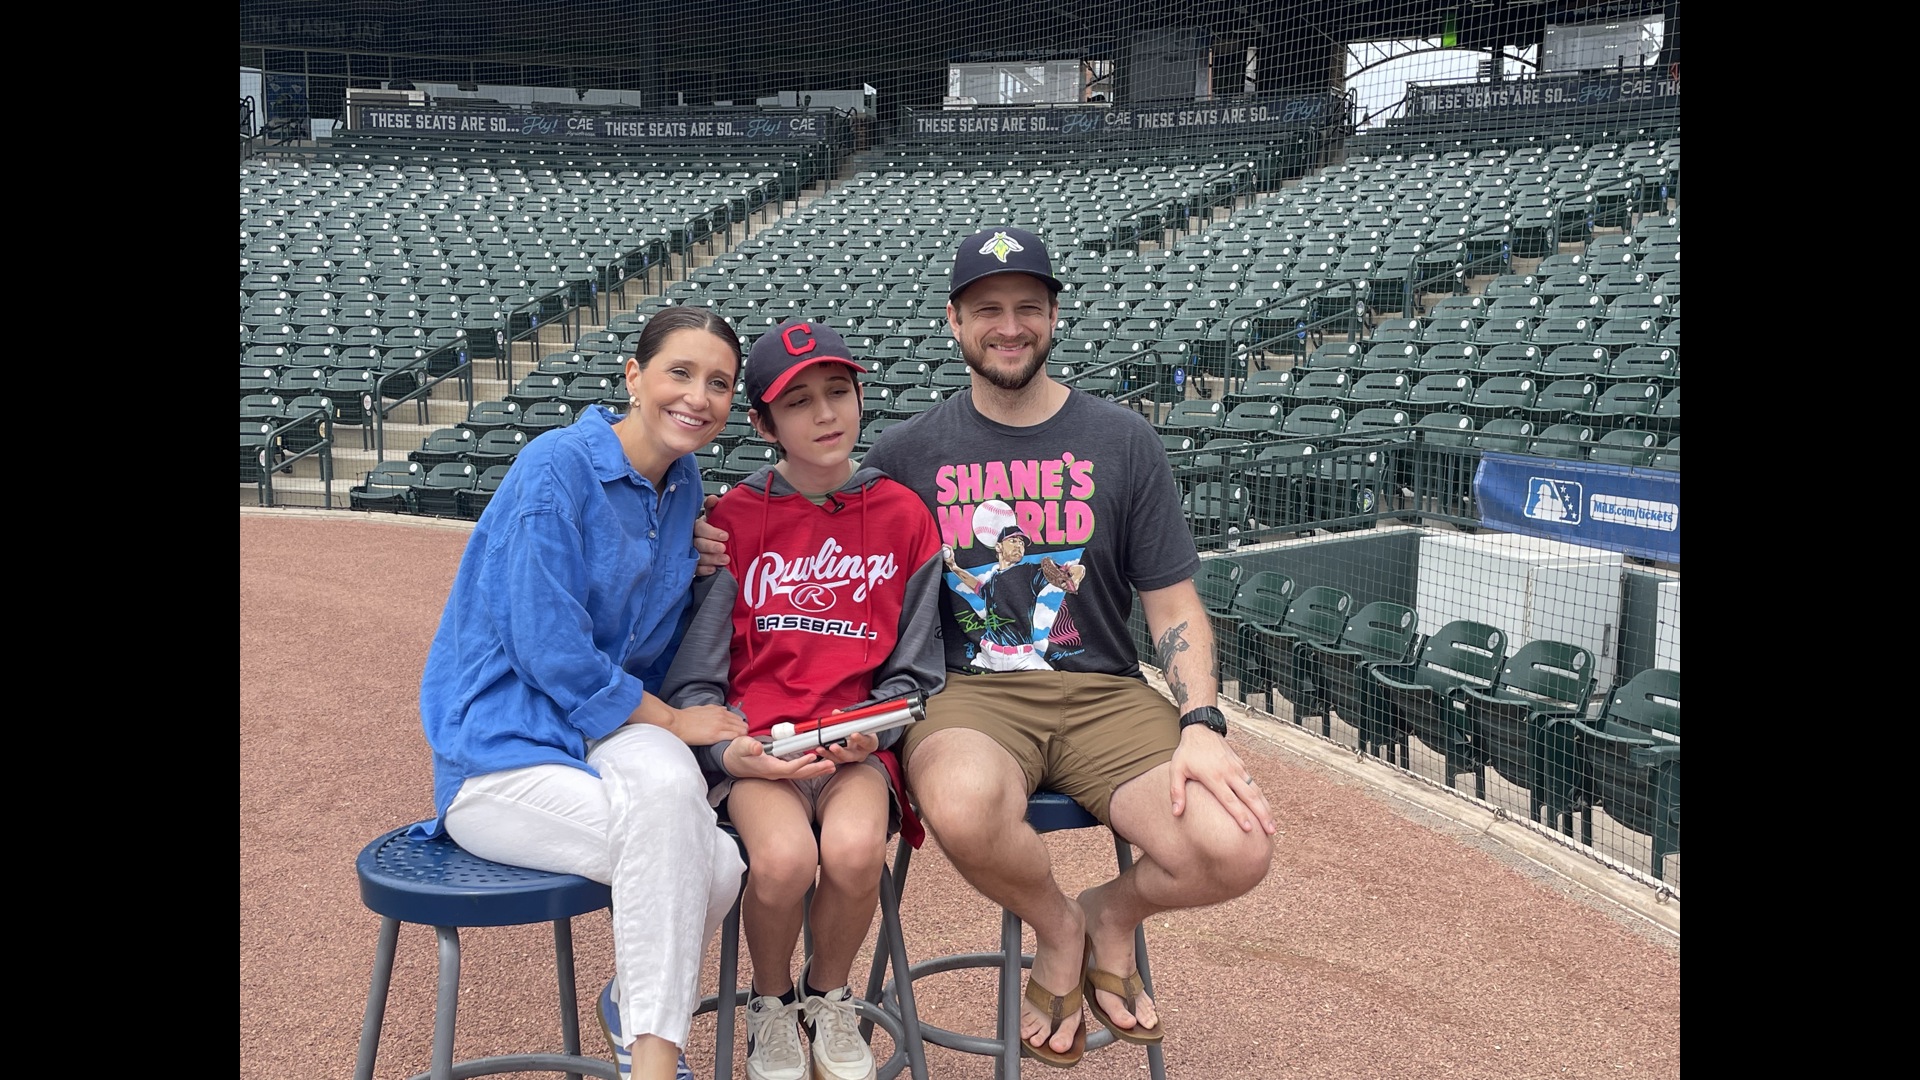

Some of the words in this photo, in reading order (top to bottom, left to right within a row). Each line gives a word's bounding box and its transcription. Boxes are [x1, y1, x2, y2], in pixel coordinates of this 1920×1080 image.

[1421, 93, 1462, 110] THESE
[1465, 90, 1509, 107] SEATS
[1513, 88, 1539, 105] ARE
[1545, 87, 1576, 103] SO...
[1621, 80, 1652, 94] CAE
[370, 112, 411, 128] THESE
[416, 114, 456, 130] SEATS
[461, 116, 486, 132] ARE
[490, 117, 519, 133] SO...
[522, 115, 559, 135] Fly!
[567, 118, 594, 131] CAE
[790, 118, 816, 131] CAE
[917, 118, 956, 132] THESE
[960, 117, 998, 132] SEATS
[1002, 116, 1026, 132] ARE
[1030, 116, 1058, 132] SO...
[1062, 114, 1098, 134] Fly!
[1105, 112, 1131, 126] CAE
[1137, 111, 1175, 128] THESE
[1178, 110, 1218, 126] SEATS
[1222, 108, 1246, 124] ARE
[1250, 106, 1279, 122] SO...
[605, 122, 645, 136] THESE
[649, 122, 686, 136] SEATS
[690, 122, 713, 136] ARE
[717, 122, 744, 136] SO...
[747, 120, 781, 138] Fly!
[781, 322, 816, 356] C
[935, 451, 1095, 505] SHANE'S
[1593, 500, 1673, 523] MiLB.com/tickets
[936, 499, 1096, 550] WORLD
[744, 537, 898, 609] Rawlings
[756, 614, 878, 640] BASEBALL
